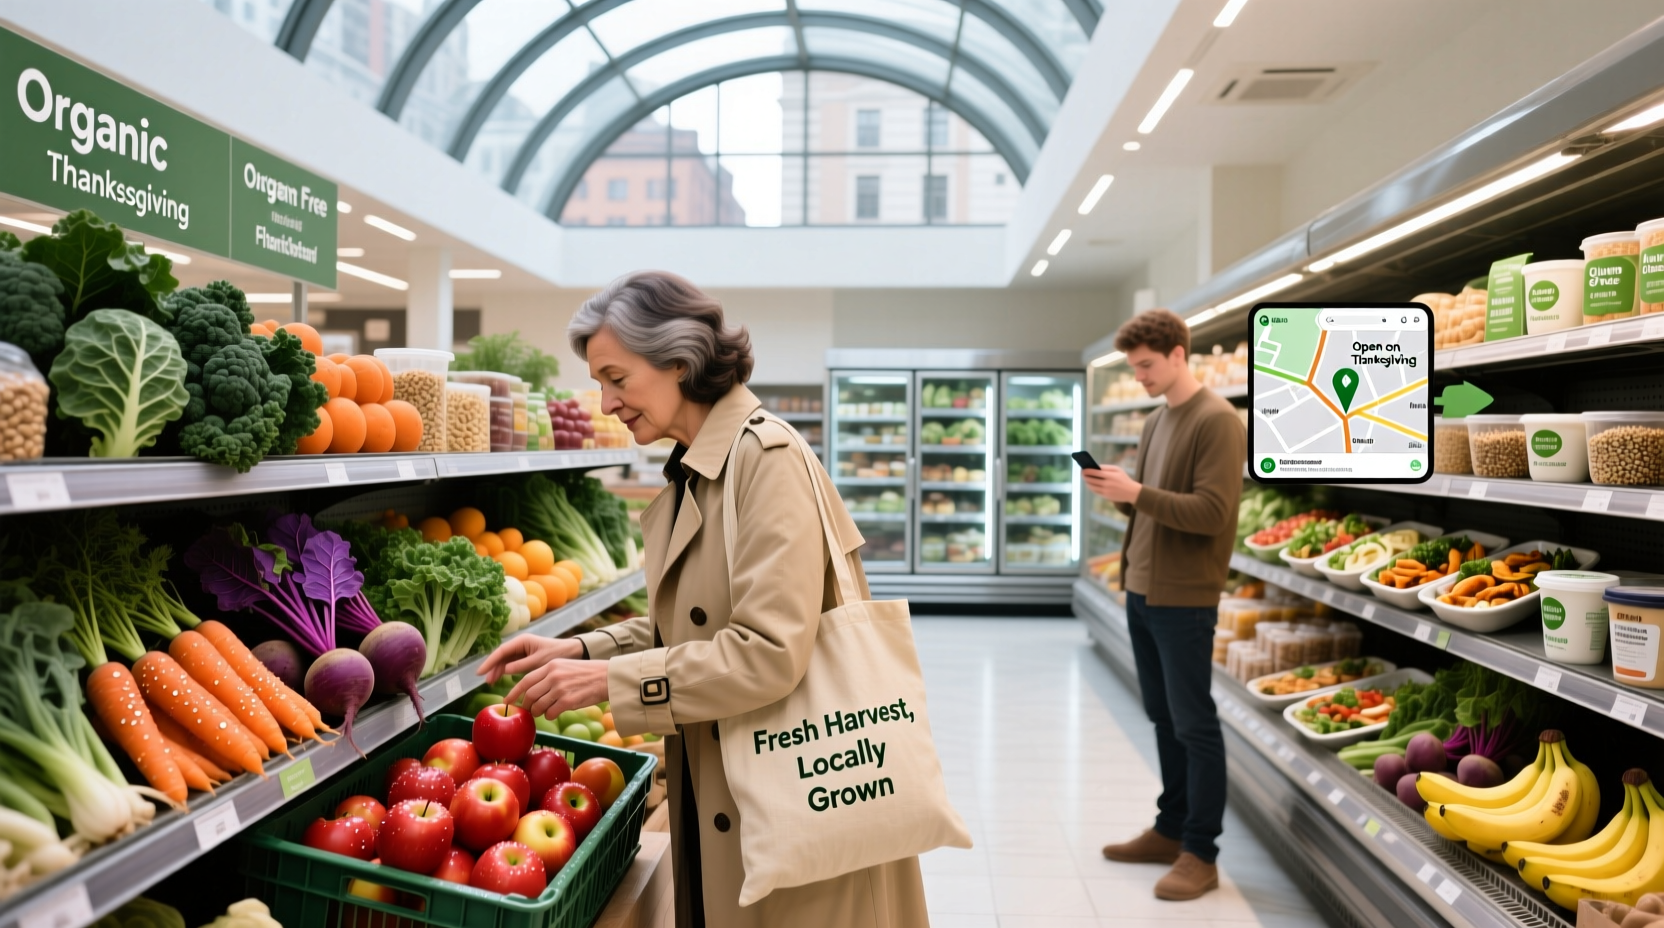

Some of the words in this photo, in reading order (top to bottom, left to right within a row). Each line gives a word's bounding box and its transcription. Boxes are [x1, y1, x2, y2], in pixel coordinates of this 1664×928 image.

[17, 67, 168, 172] Organic
[1352, 341, 1383, 356] Open
[1385, 343, 1401, 353] on
[753, 718, 820, 755] Fresh
[823, 697, 915, 738] Harvest,
[796, 737, 886, 780] Locally
[807, 776, 895, 812] Grown
